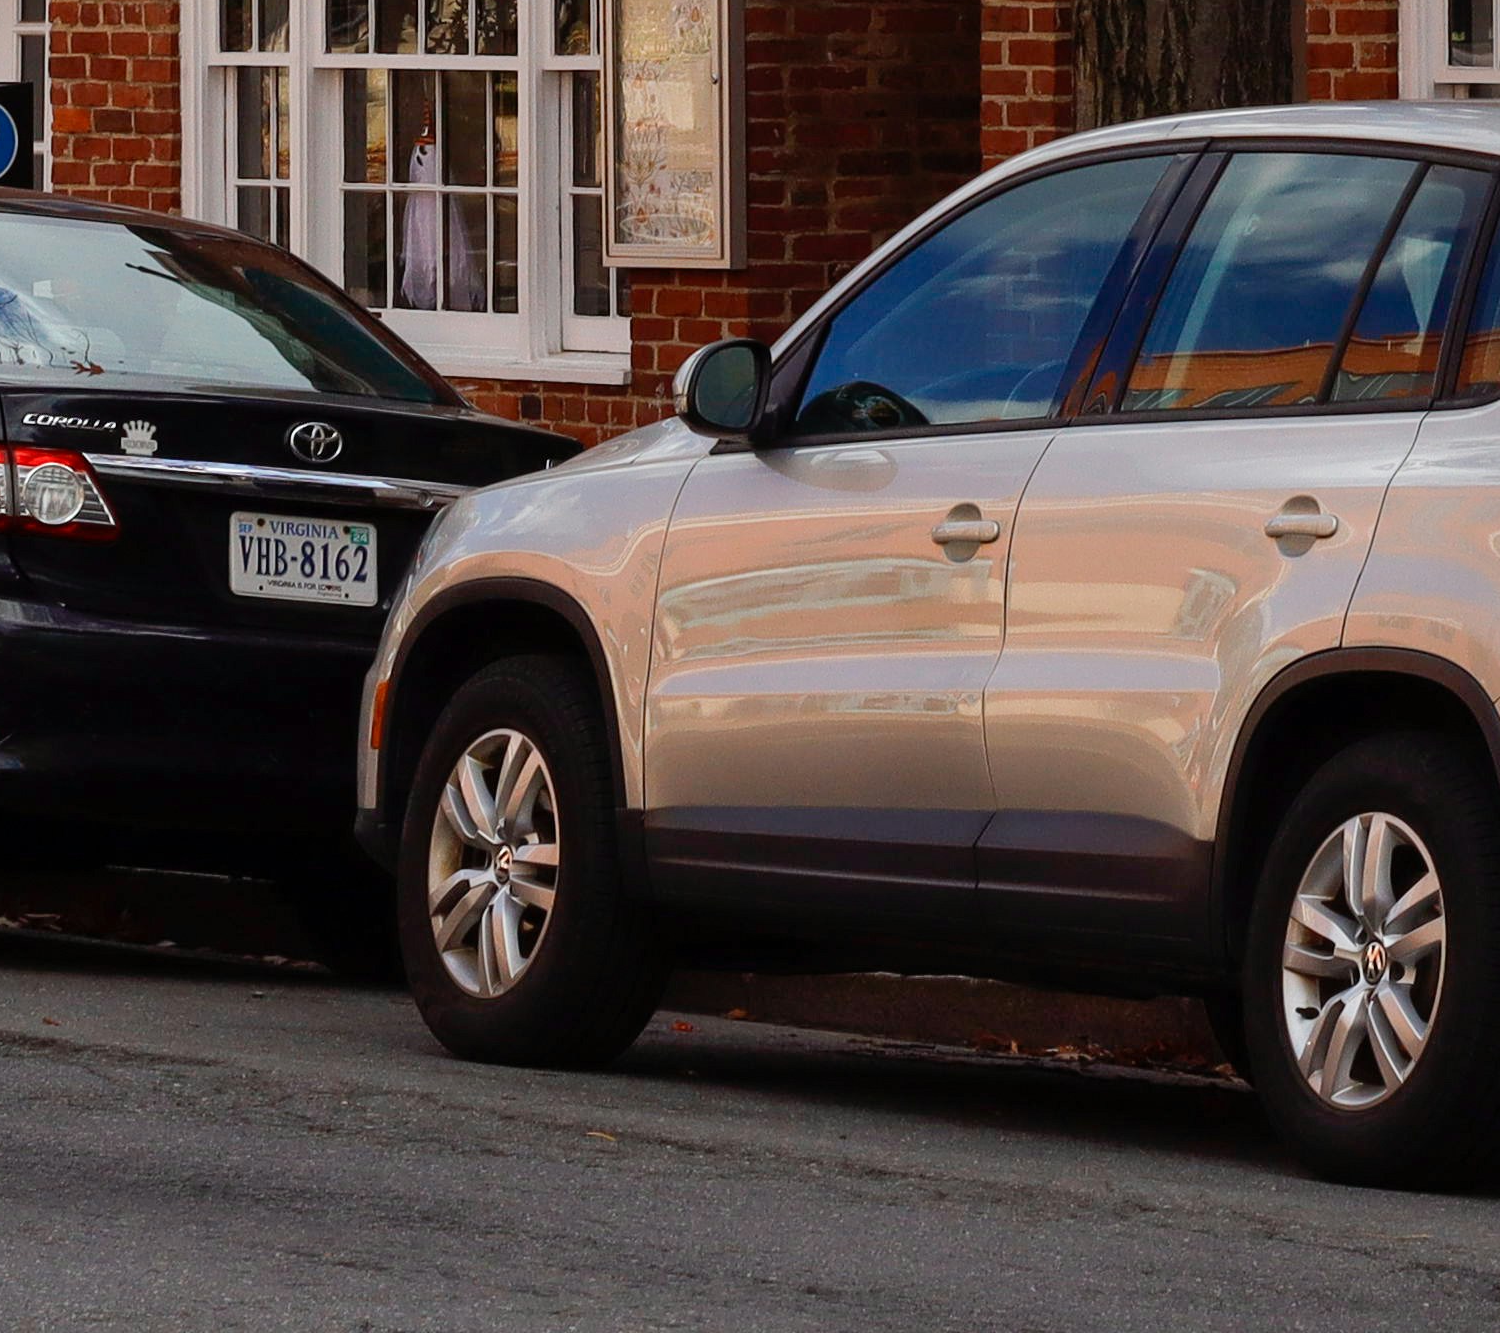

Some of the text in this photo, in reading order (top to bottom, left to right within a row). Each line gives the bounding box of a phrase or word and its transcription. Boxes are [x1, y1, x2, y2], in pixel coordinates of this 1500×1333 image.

[23, 413, 117, 431] COROLLA
[269, 519, 339, 540] VIRGINIA
[239, 535, 368, 583] VHB-8162
